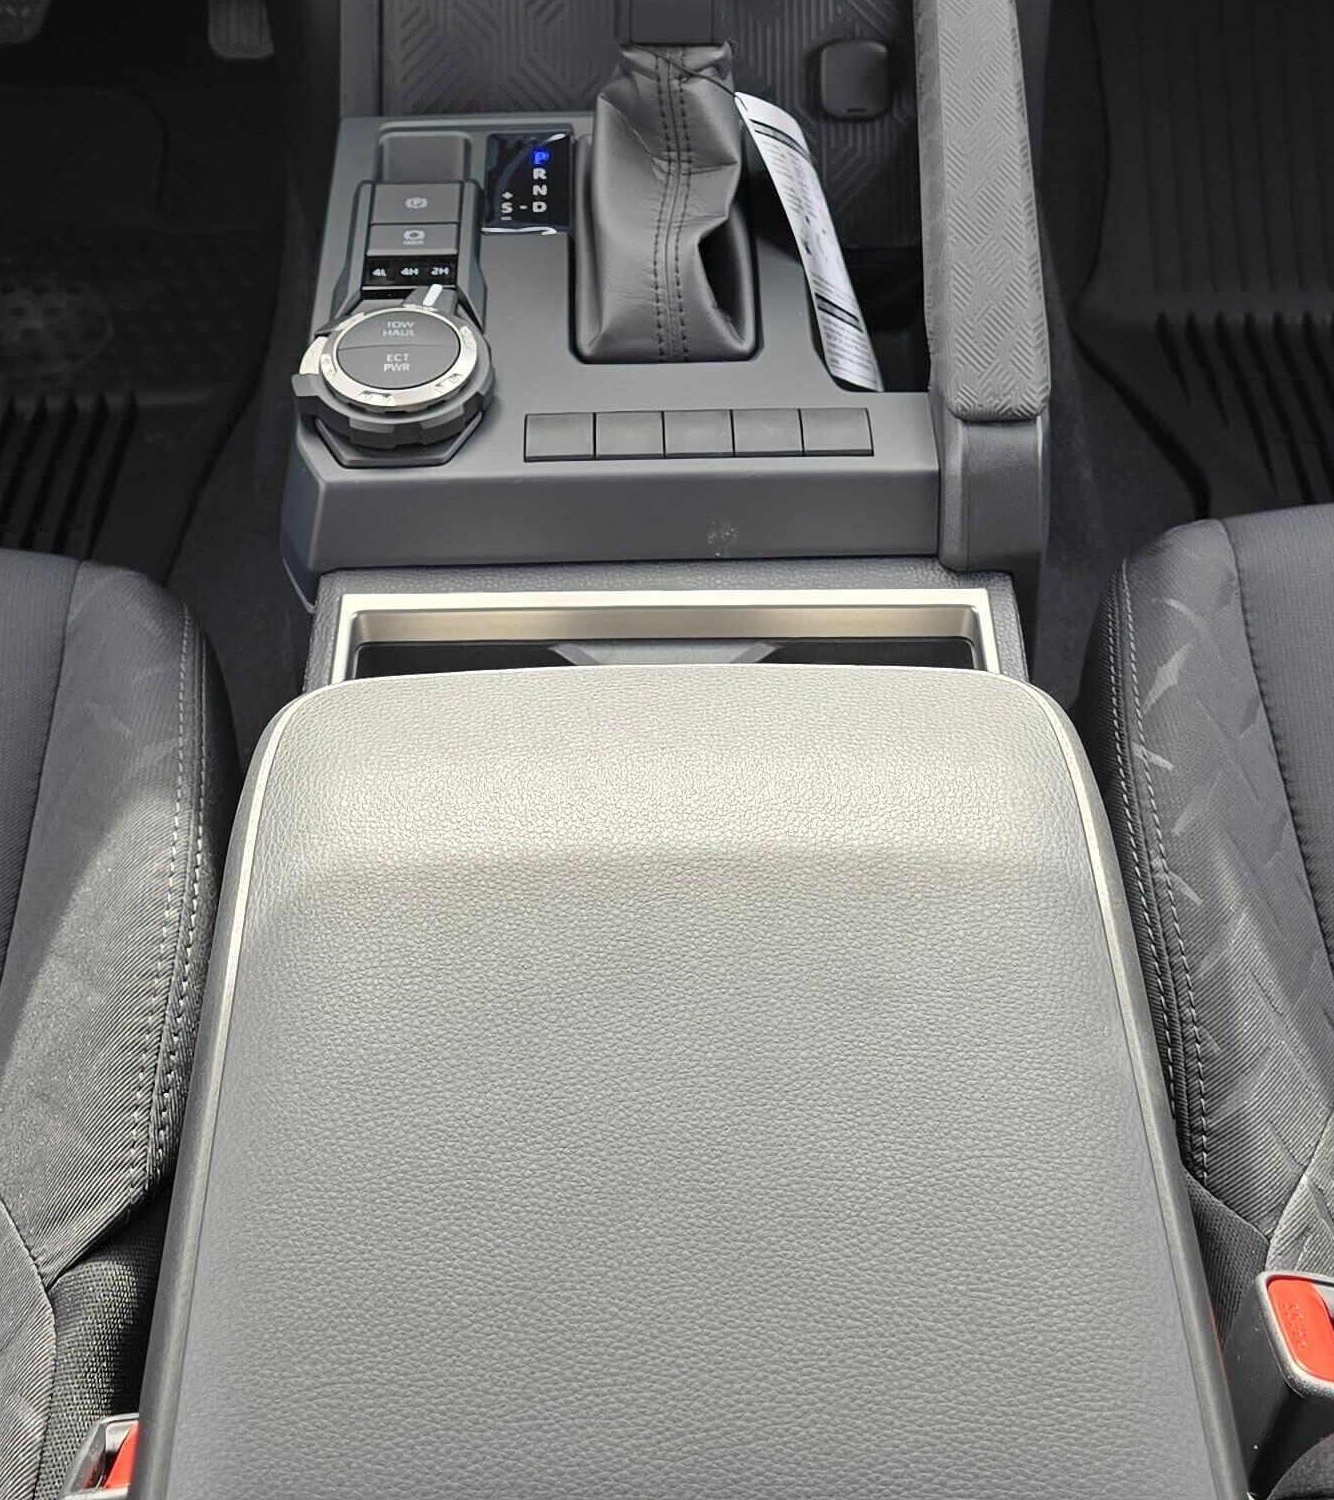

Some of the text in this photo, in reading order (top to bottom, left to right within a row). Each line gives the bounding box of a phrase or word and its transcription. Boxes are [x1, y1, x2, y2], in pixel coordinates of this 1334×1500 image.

[532, 150, 550, 164] P
[533, 168, 547, 180] R
[533, 184, 548, 196] N
[501, 202, 514, 213] S
[533, 202, 548, 213] D
[401, 267, 419, 276] 4H
[431, 267, 449, 276] 2H
[382, 329, 415, 337] HAUL
[386, 353, 410, 362] ECT
[383, 362, 411, 372] PWR
